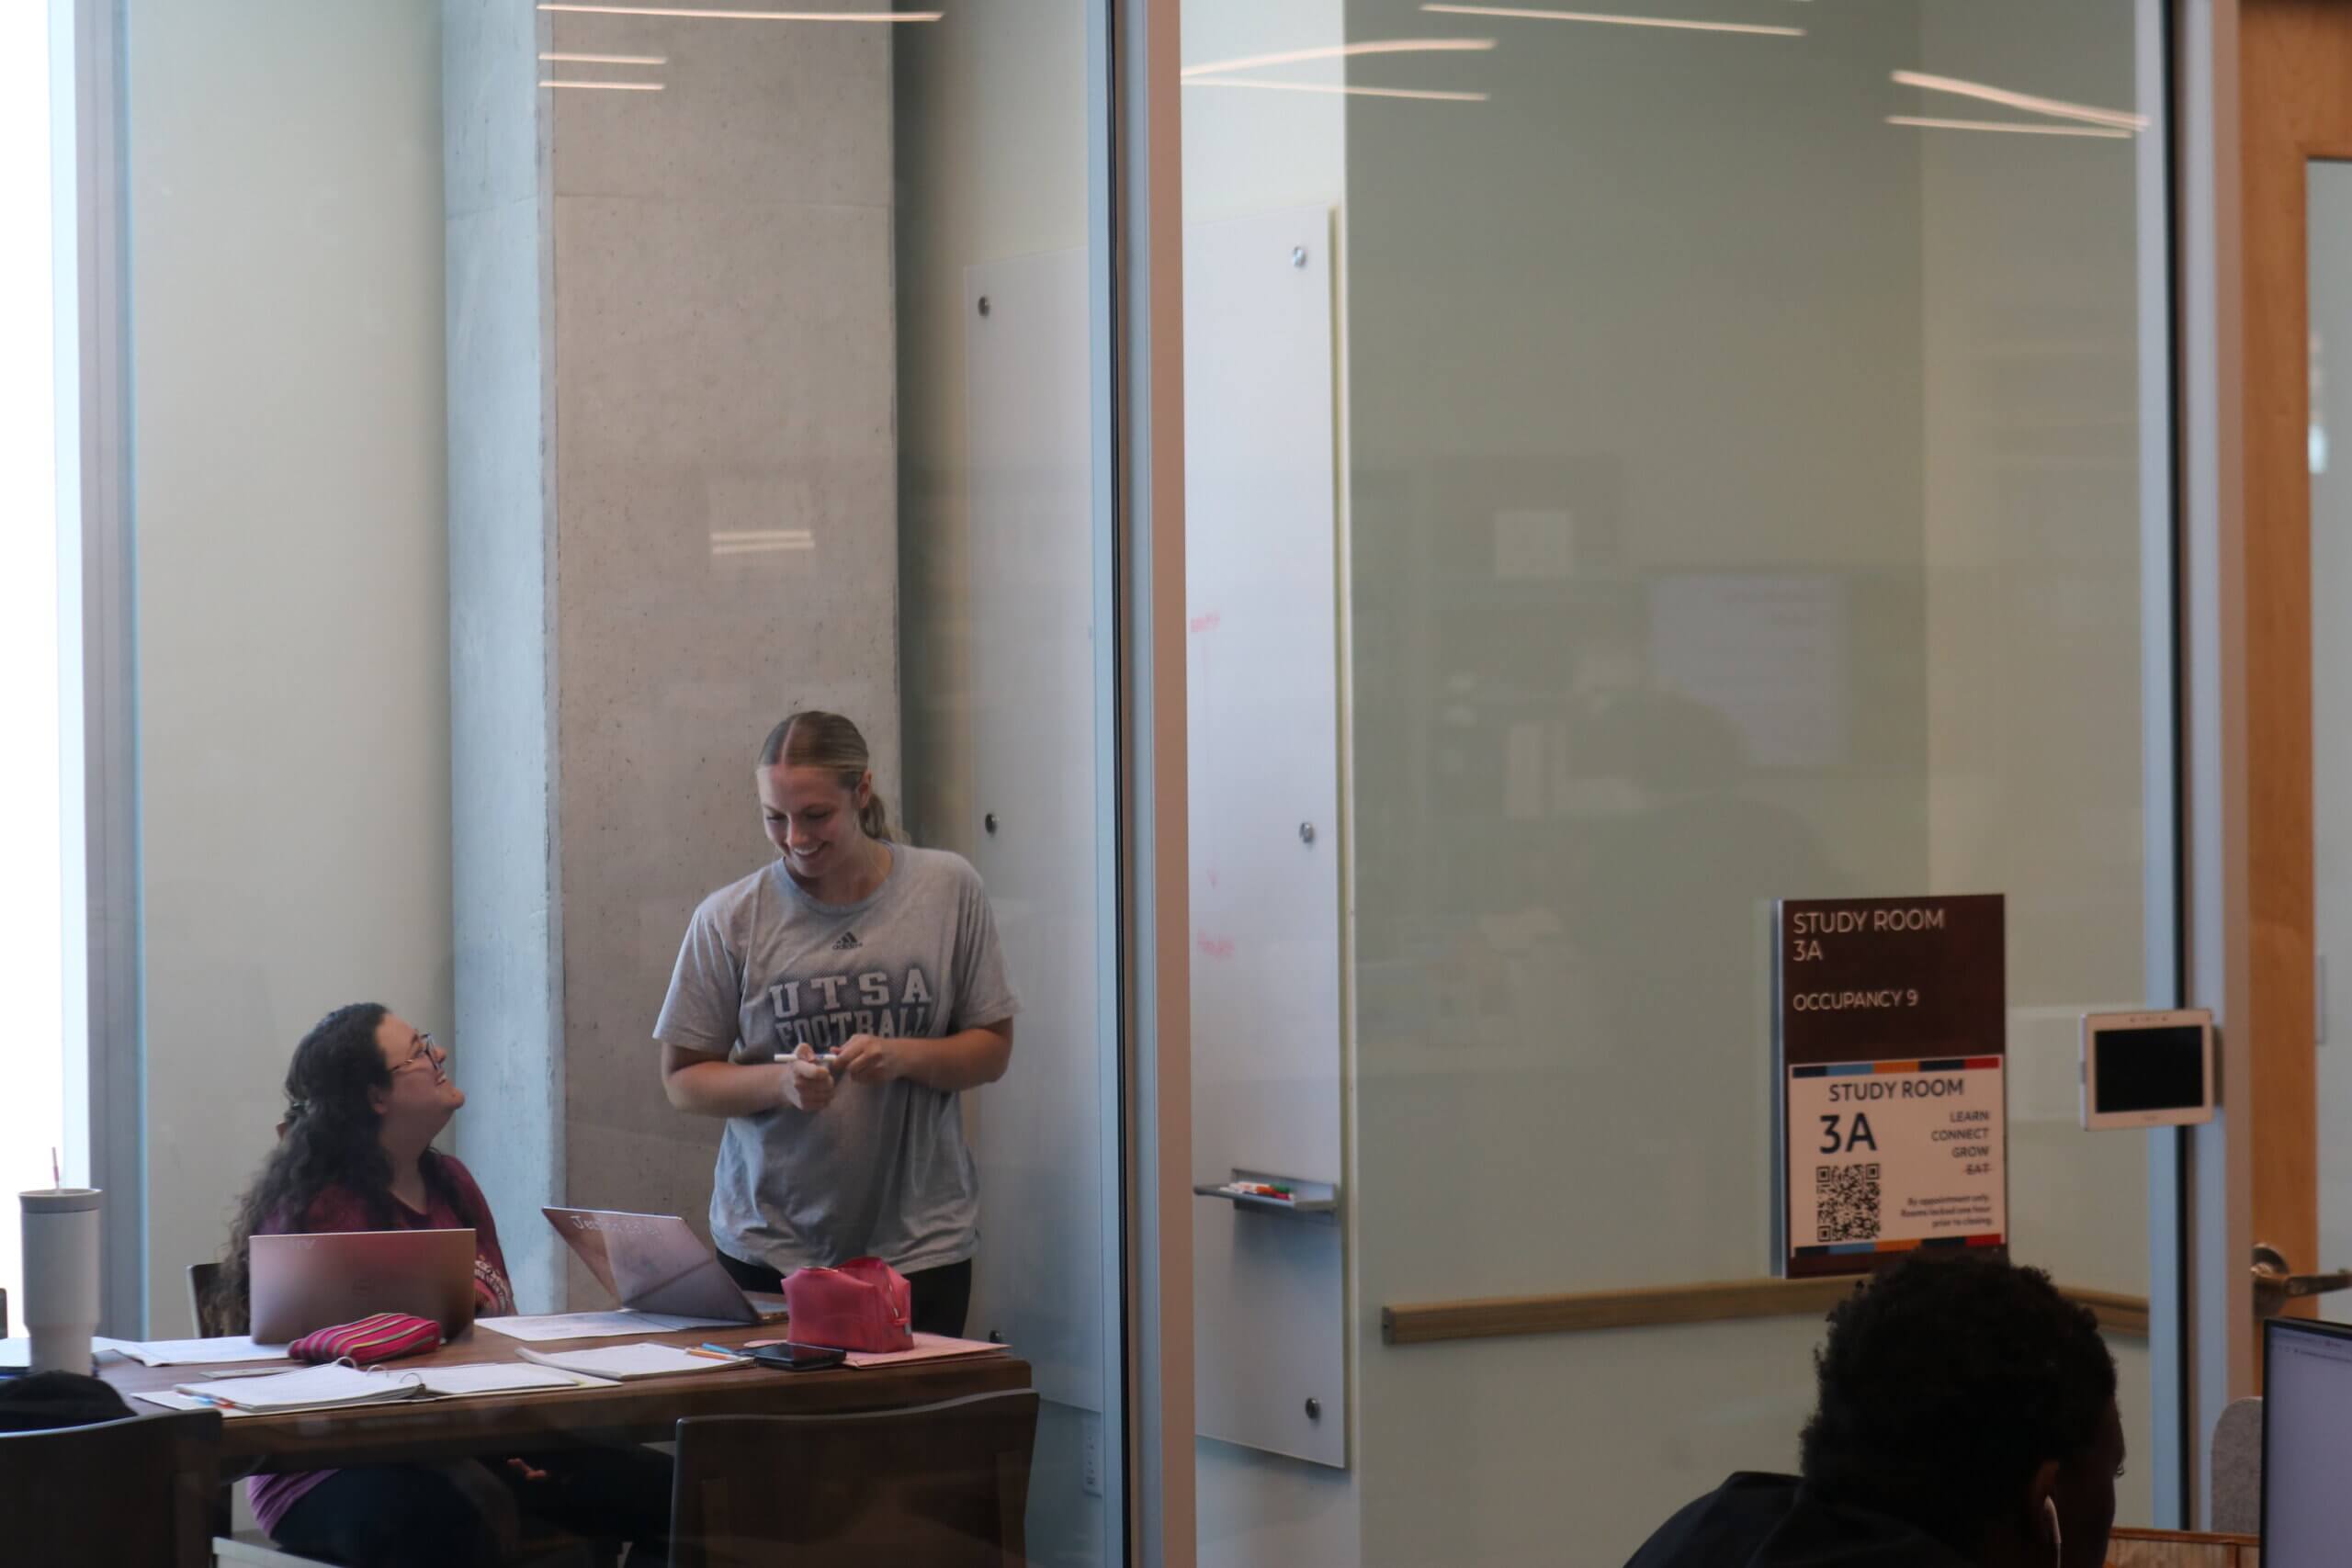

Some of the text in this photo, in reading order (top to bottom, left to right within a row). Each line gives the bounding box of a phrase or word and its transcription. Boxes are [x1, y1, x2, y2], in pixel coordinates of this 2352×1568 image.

[1792, 908, 1946, 934] STUDY ROOM
[1792, 940, 1824, 961] 3A
[769, 967, 933, 1019] UTSA
[1792, 989, 1919, 1011] OCCUPANCY 9
[1829, 1078, 1965, 1102] STUDY ROOM
[1950, 1111, 1990, 1123] LEARN
[1820, 1112, 1877, 1154] 3A
[1931, 1127, 1989, 1142] CONNECT
[1951, 1146, 1989, 1158] GROW
